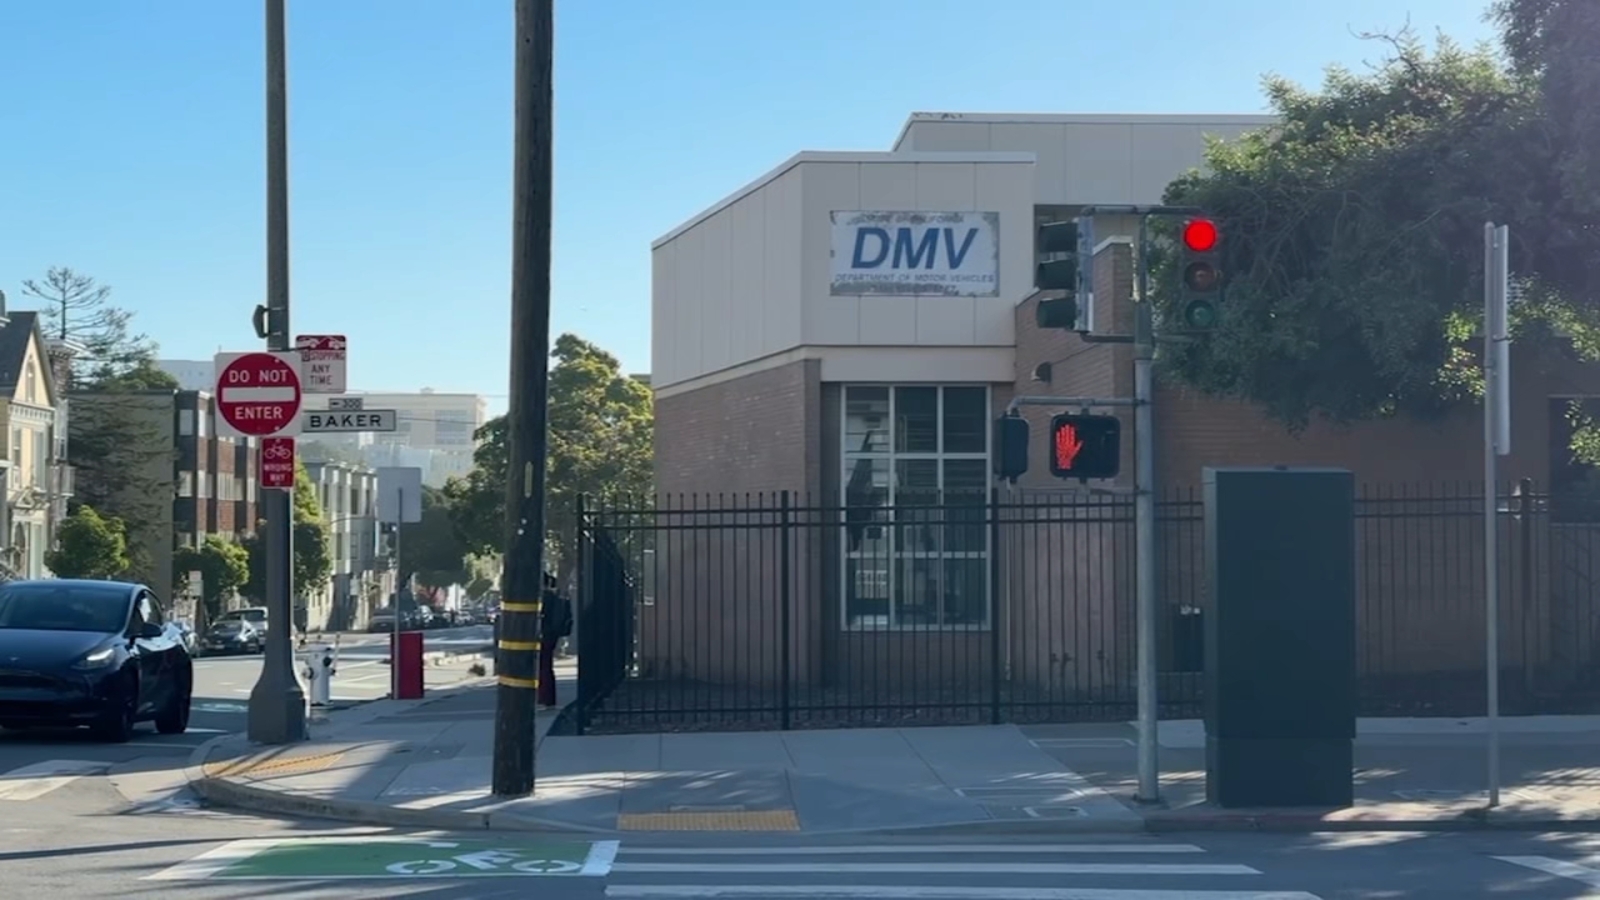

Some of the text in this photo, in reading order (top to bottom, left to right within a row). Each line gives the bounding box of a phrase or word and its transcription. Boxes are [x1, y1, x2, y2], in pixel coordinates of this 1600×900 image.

[851, 226, 979, 270] DMV
[835, 273, 994, 283] DEPARTMENT OF MOTOR VEHICLES
[311, 364, 330, 373] ANY
[229, 369, 289, 383] DO NOT
[310, 375, 333, 385] TIME
[234, 406, 283, 420] ENTER
[309, 414, 382, 428] BAKER
[264, 463, 292, 472] WRONG
[269, 473, 286, 482] WAY
